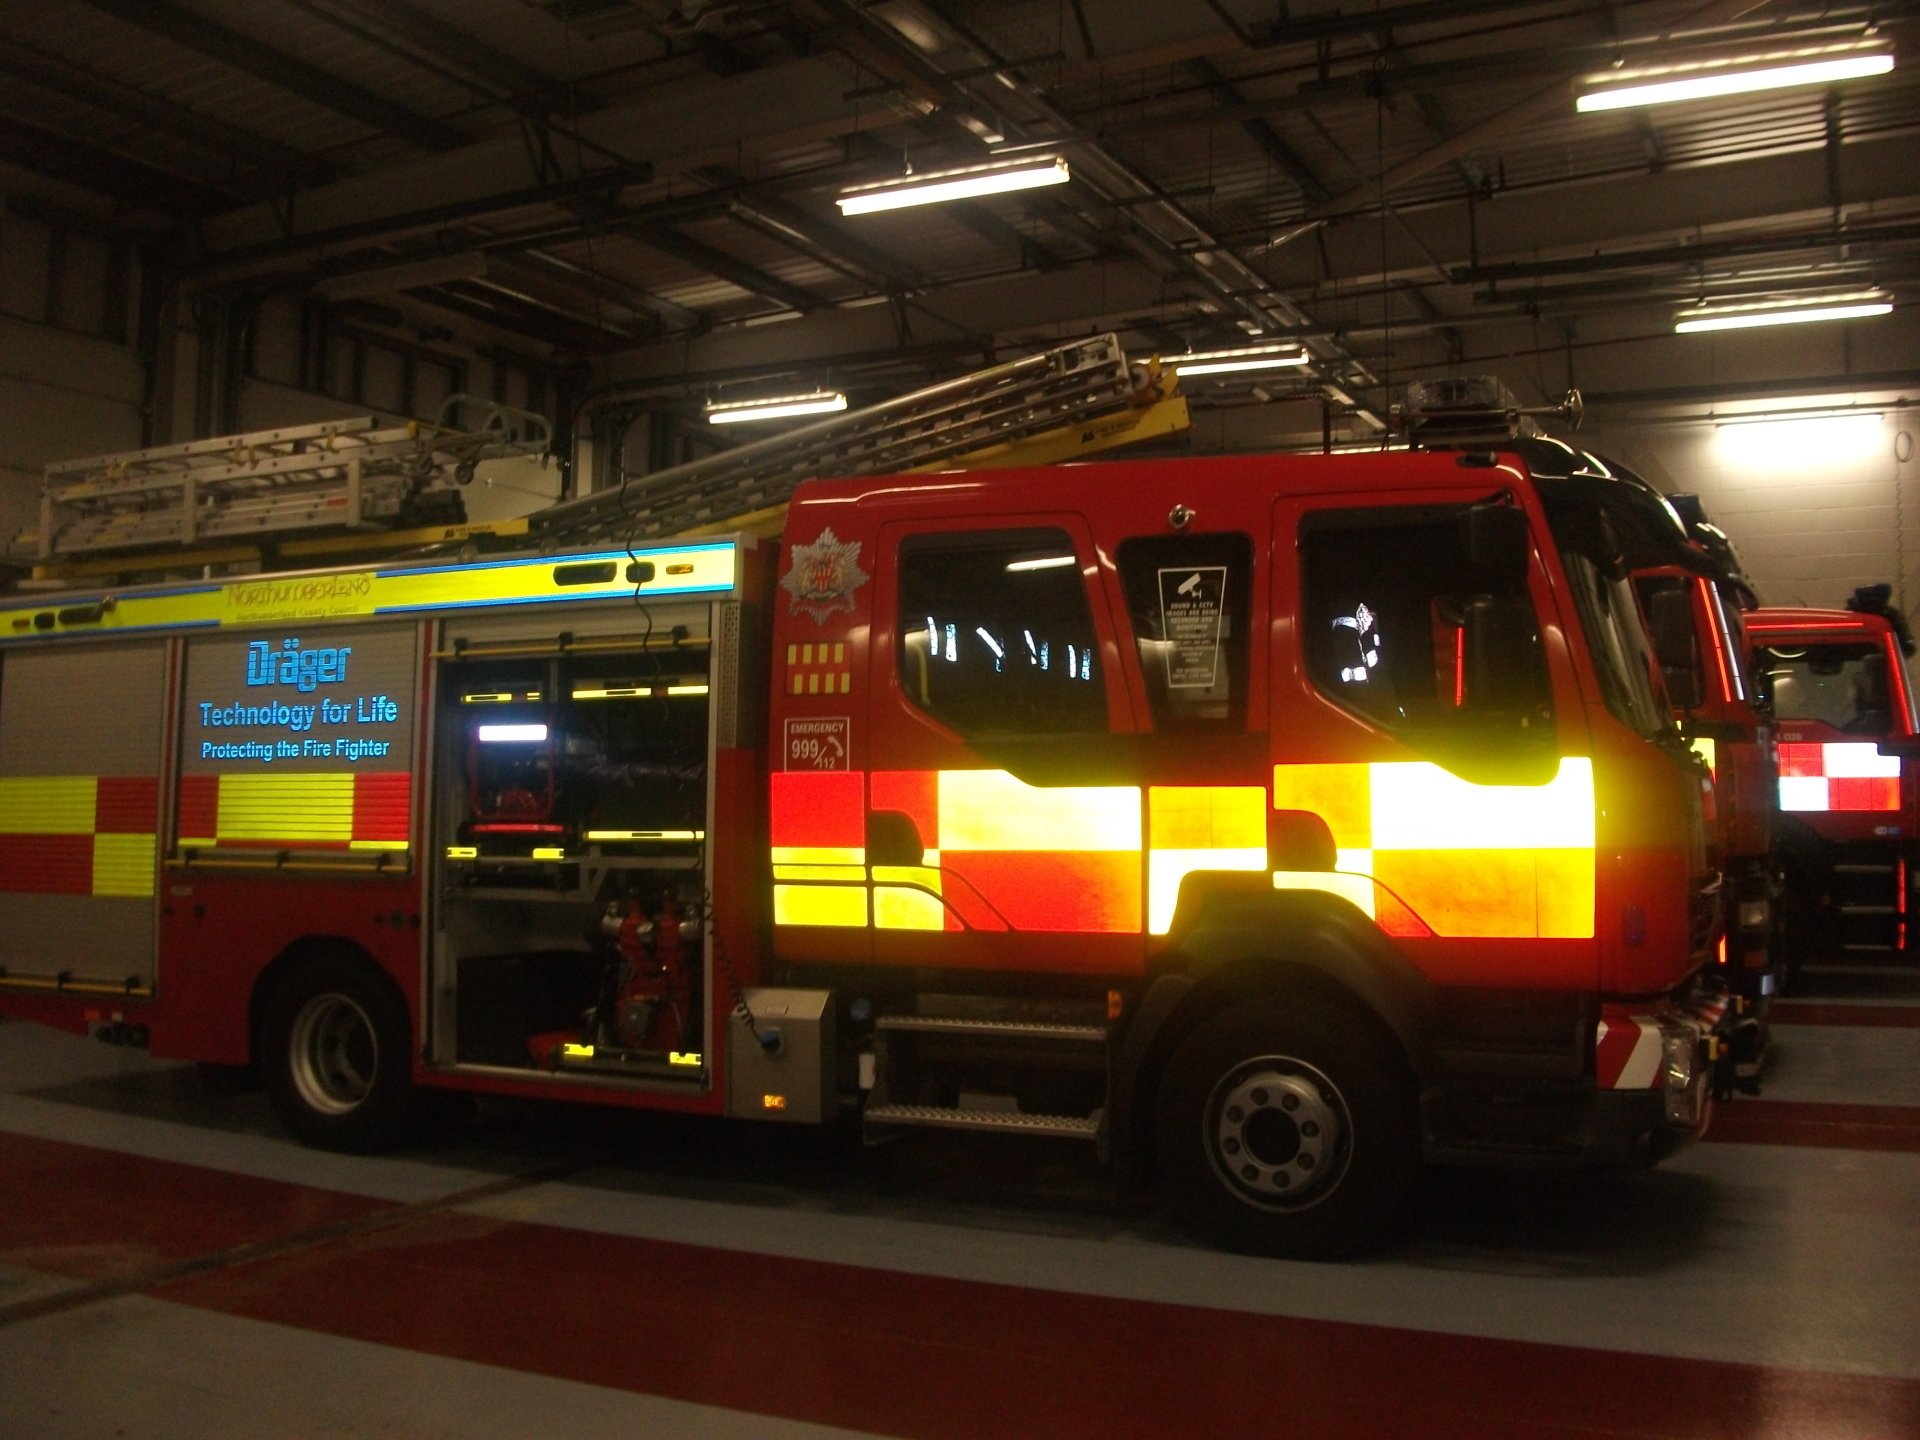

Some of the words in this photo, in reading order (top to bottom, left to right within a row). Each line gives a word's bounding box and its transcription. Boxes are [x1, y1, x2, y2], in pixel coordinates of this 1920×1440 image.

[246, 638, 352, 692] Dräger
[200, 701, 317, 731] Technology
[321, 698, 353, 723] for
[357, 695, 398, 723] Life
[790, 721, 844, 734] EMERGENCY
[202, 741, 274, 762] Protecting
[276, 741, 300, 758] the
[303, 739, 332, 757] Fire
[335, 739, 390, 761] Fighter
